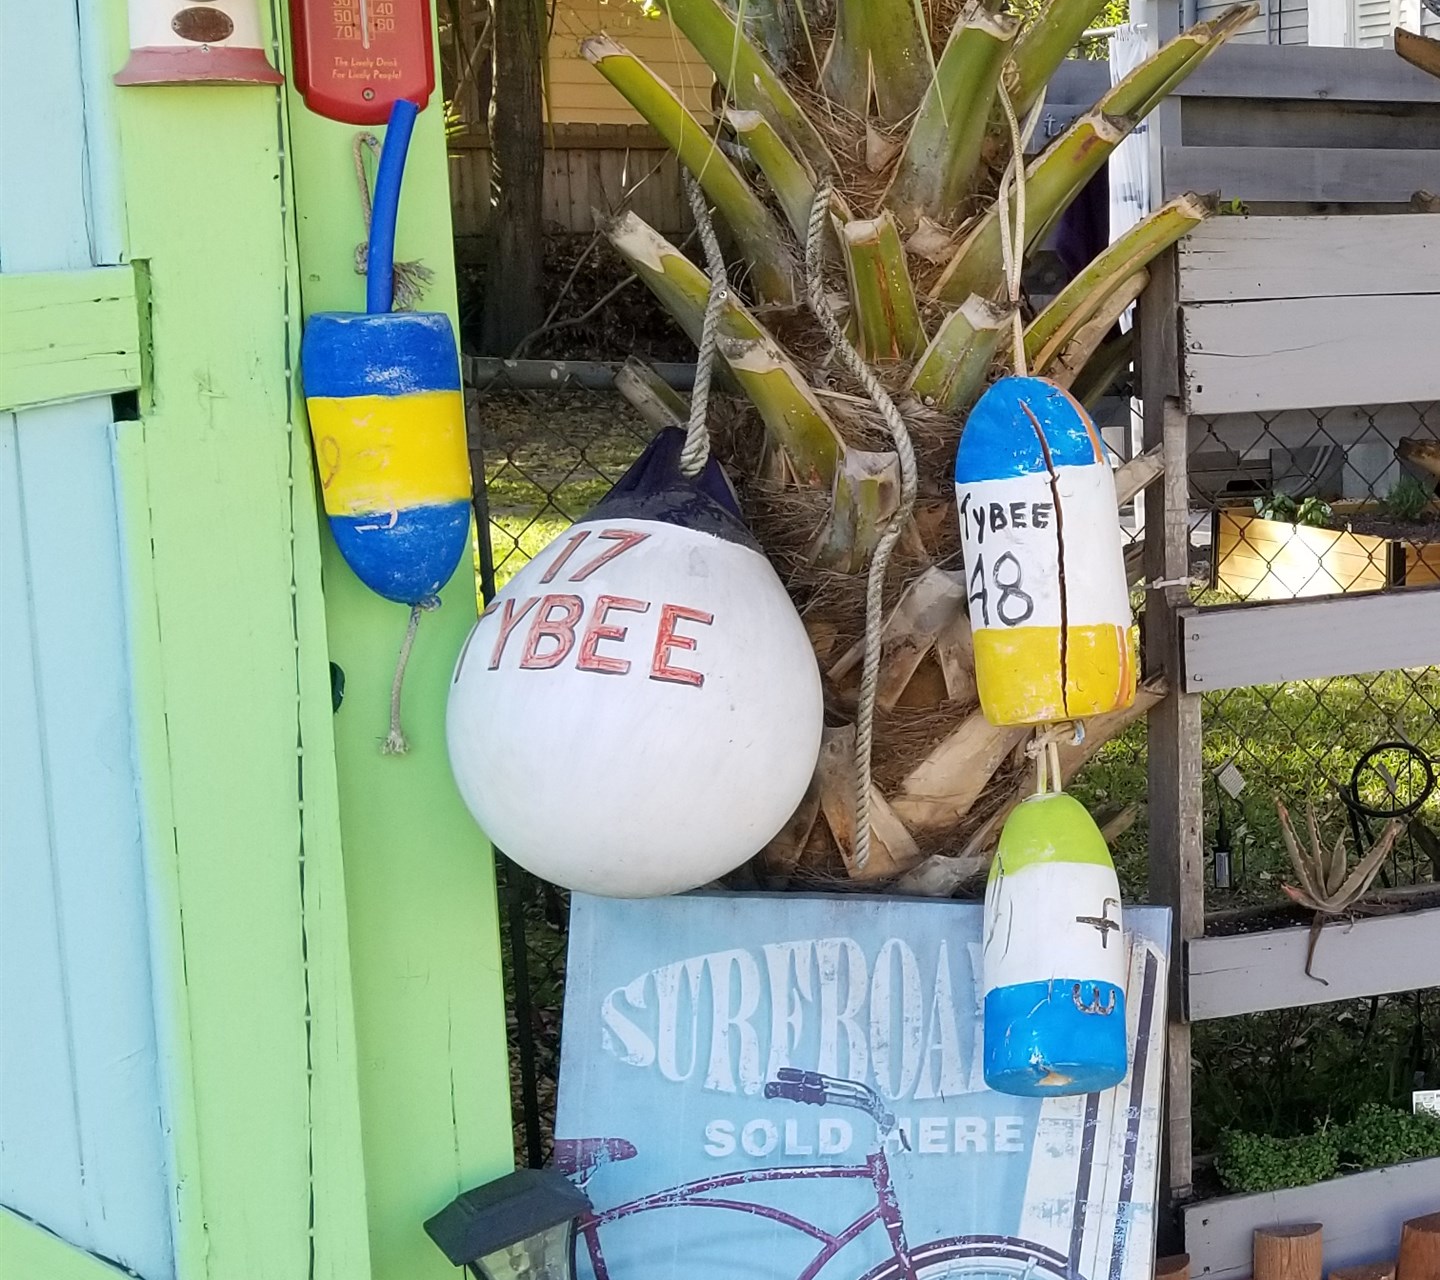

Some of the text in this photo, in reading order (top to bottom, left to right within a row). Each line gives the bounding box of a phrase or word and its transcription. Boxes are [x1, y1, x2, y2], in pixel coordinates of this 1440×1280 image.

[376, 2, 393, 15] 40
[333, 9, 352, 22] 50
[335, 25, 353, 38] 70
[539, 528, 653, 584] 17
[703, 1118, 854, 1158] SOLD
